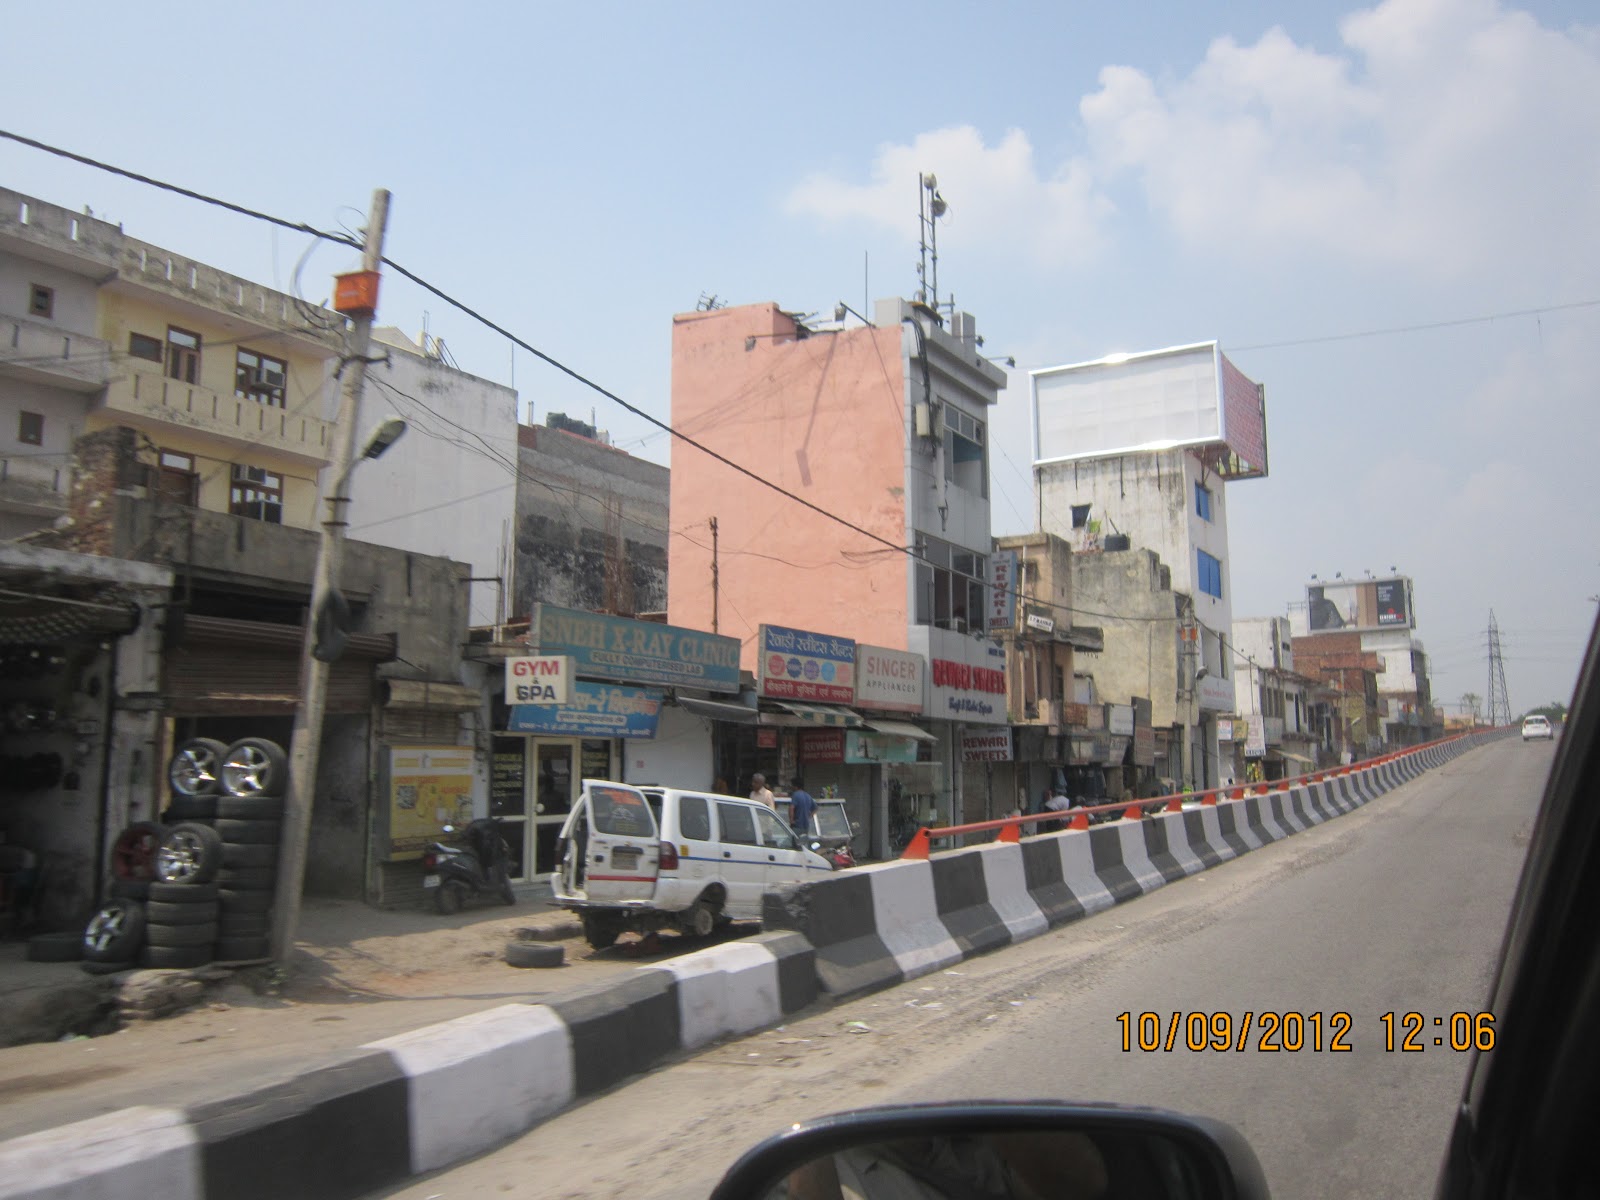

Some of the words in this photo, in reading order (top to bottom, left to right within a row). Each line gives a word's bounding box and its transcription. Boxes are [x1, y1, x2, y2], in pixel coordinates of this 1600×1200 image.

[611, 625, 675, 659] X-RAY
[678, 636, 739, 669] CLINIC
[513, 660, 560, 677] GYM
[866, 655, 916, 681] SINGER
[866, 679, 916, 694] APPLIANCES
[962, 736, 1008, 750] REWARI
[964, 749, 1008, 761] SWEETS
